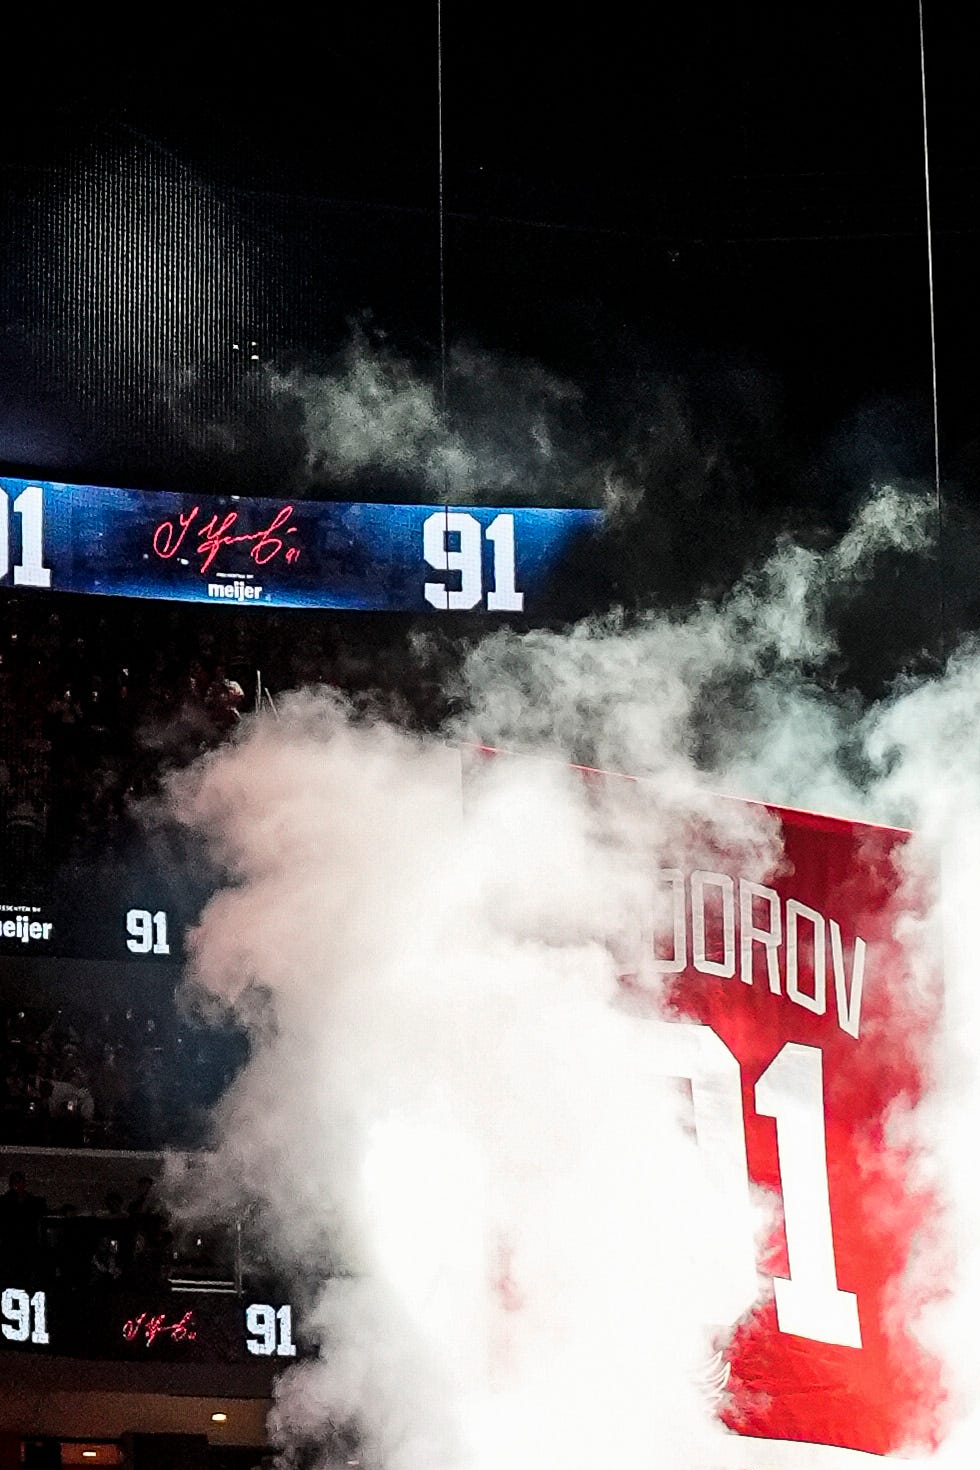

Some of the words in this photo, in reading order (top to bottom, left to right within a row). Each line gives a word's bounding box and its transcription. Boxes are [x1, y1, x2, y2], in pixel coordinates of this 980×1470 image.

[0, 486, 51, 587] 1
[423, 512, 524, 612] 91
[208, 581, 262, 601] meijer
[0, 915, 52, 942] eijer
[126, 909, 171, 954] 91
[650, 868, 866, 1040] DOROV
[1, 1288, 49, 1344] 91
[246, 1303, 296, 1356] 91
